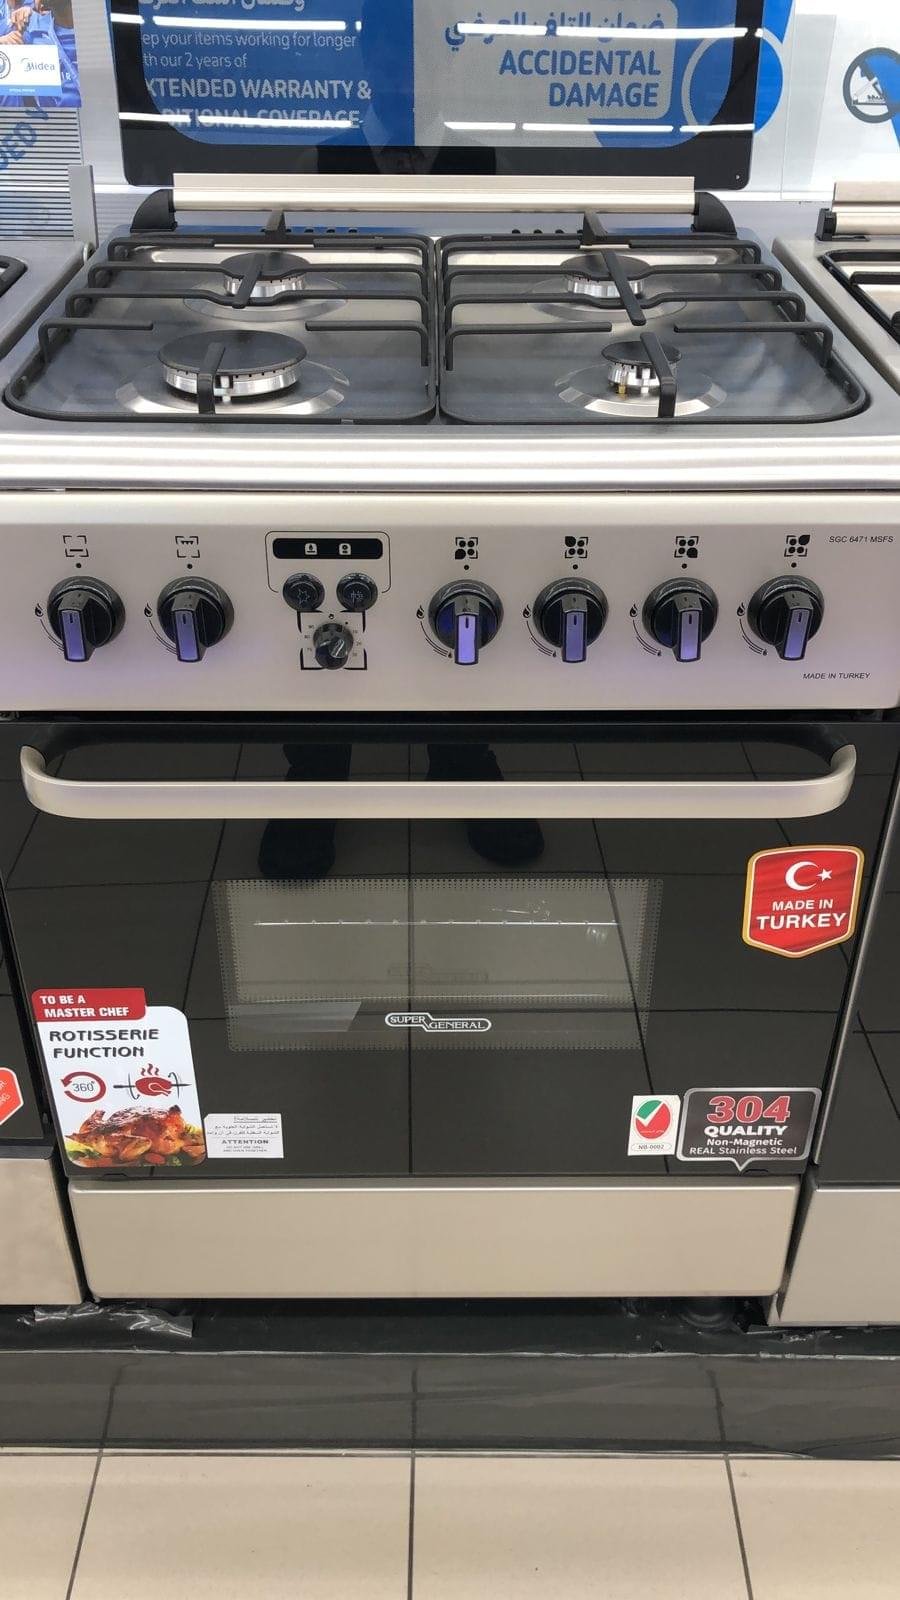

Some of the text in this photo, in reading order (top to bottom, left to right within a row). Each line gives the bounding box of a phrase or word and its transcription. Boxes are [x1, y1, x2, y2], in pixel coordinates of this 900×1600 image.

[142, 31, 357, 51] ep your items working for longer
[23, 58, 56, 71] Midea
[142, 52, 248, 69] th our 2 years of
[499, 50, 661, 75] ACCIDENTAL
[240, 79, 354, 99] WARRANTY
[357, 80, 372, 99] &
[549, 82, 660, 107] DAMAGE
[829, 535, 848, 543] SGC
[869, 535, 894, 543] MSFS
[803, 672, 871, 680] MADE IN TURKEY
[772, 899, 834, 911] MADE IN
[756, 913, 847, 930] TURKEY
[40, 995, 86, 1004] TO BE A
[44, 1007, 130, 1018] MASTER CHEF
[390, 1015, 486, 1029] SUPER GENERAL
[49, 1028, 160, 1042] ROTISSERIE
[54, 1046, 145, 1058] FUNCTION
[706, 1095, 791, 1124] 304
[704, 1125, 788, 1137] QUALITY
[706, 1137, 783, 1147] Non-Magnetic
[770, 1146, 797, 1154] Steel
